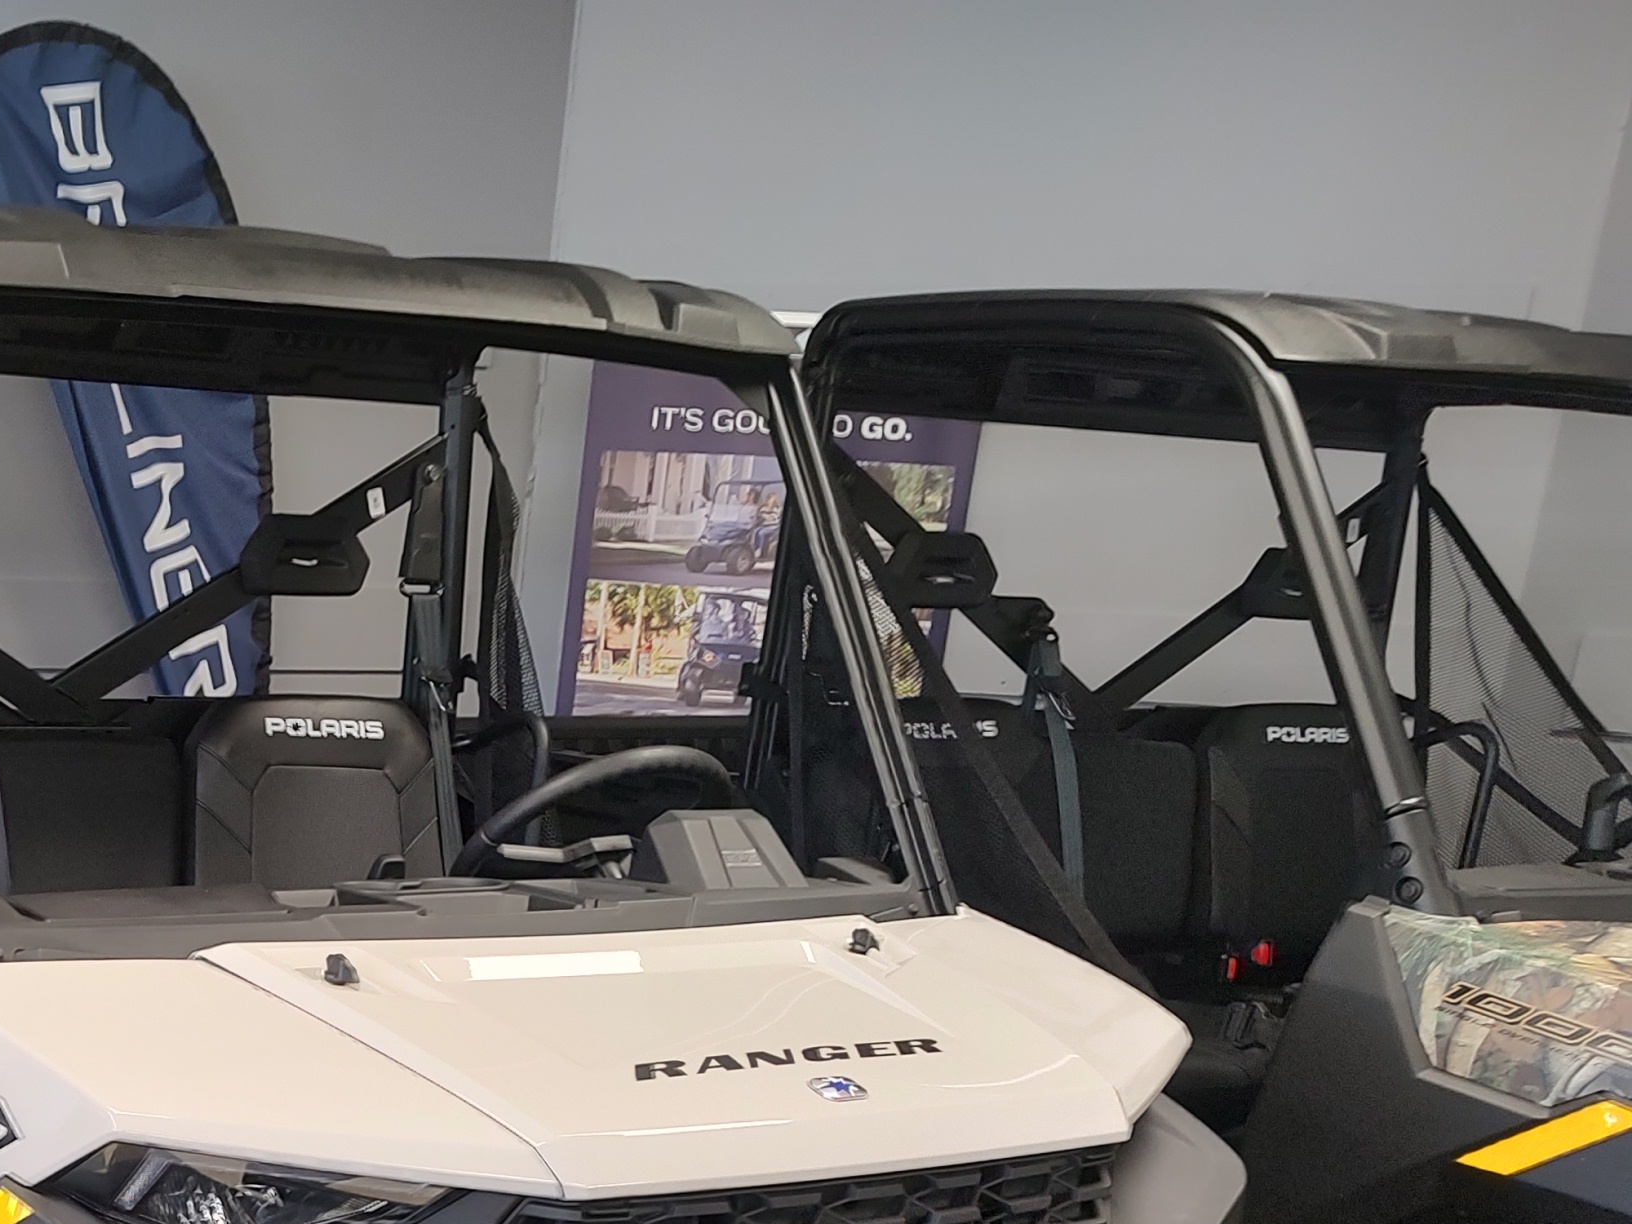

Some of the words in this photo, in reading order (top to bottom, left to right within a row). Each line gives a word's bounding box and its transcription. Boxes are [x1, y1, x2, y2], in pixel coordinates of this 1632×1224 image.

[650, 405, 705, 433] IT'S
[712, 408, 771, 434] GO
[264, 717, 385, 740] POLARIS
[1266, 726, 1350, 744] POLARIS
[633, 1037, 944, 1083] RANGER
